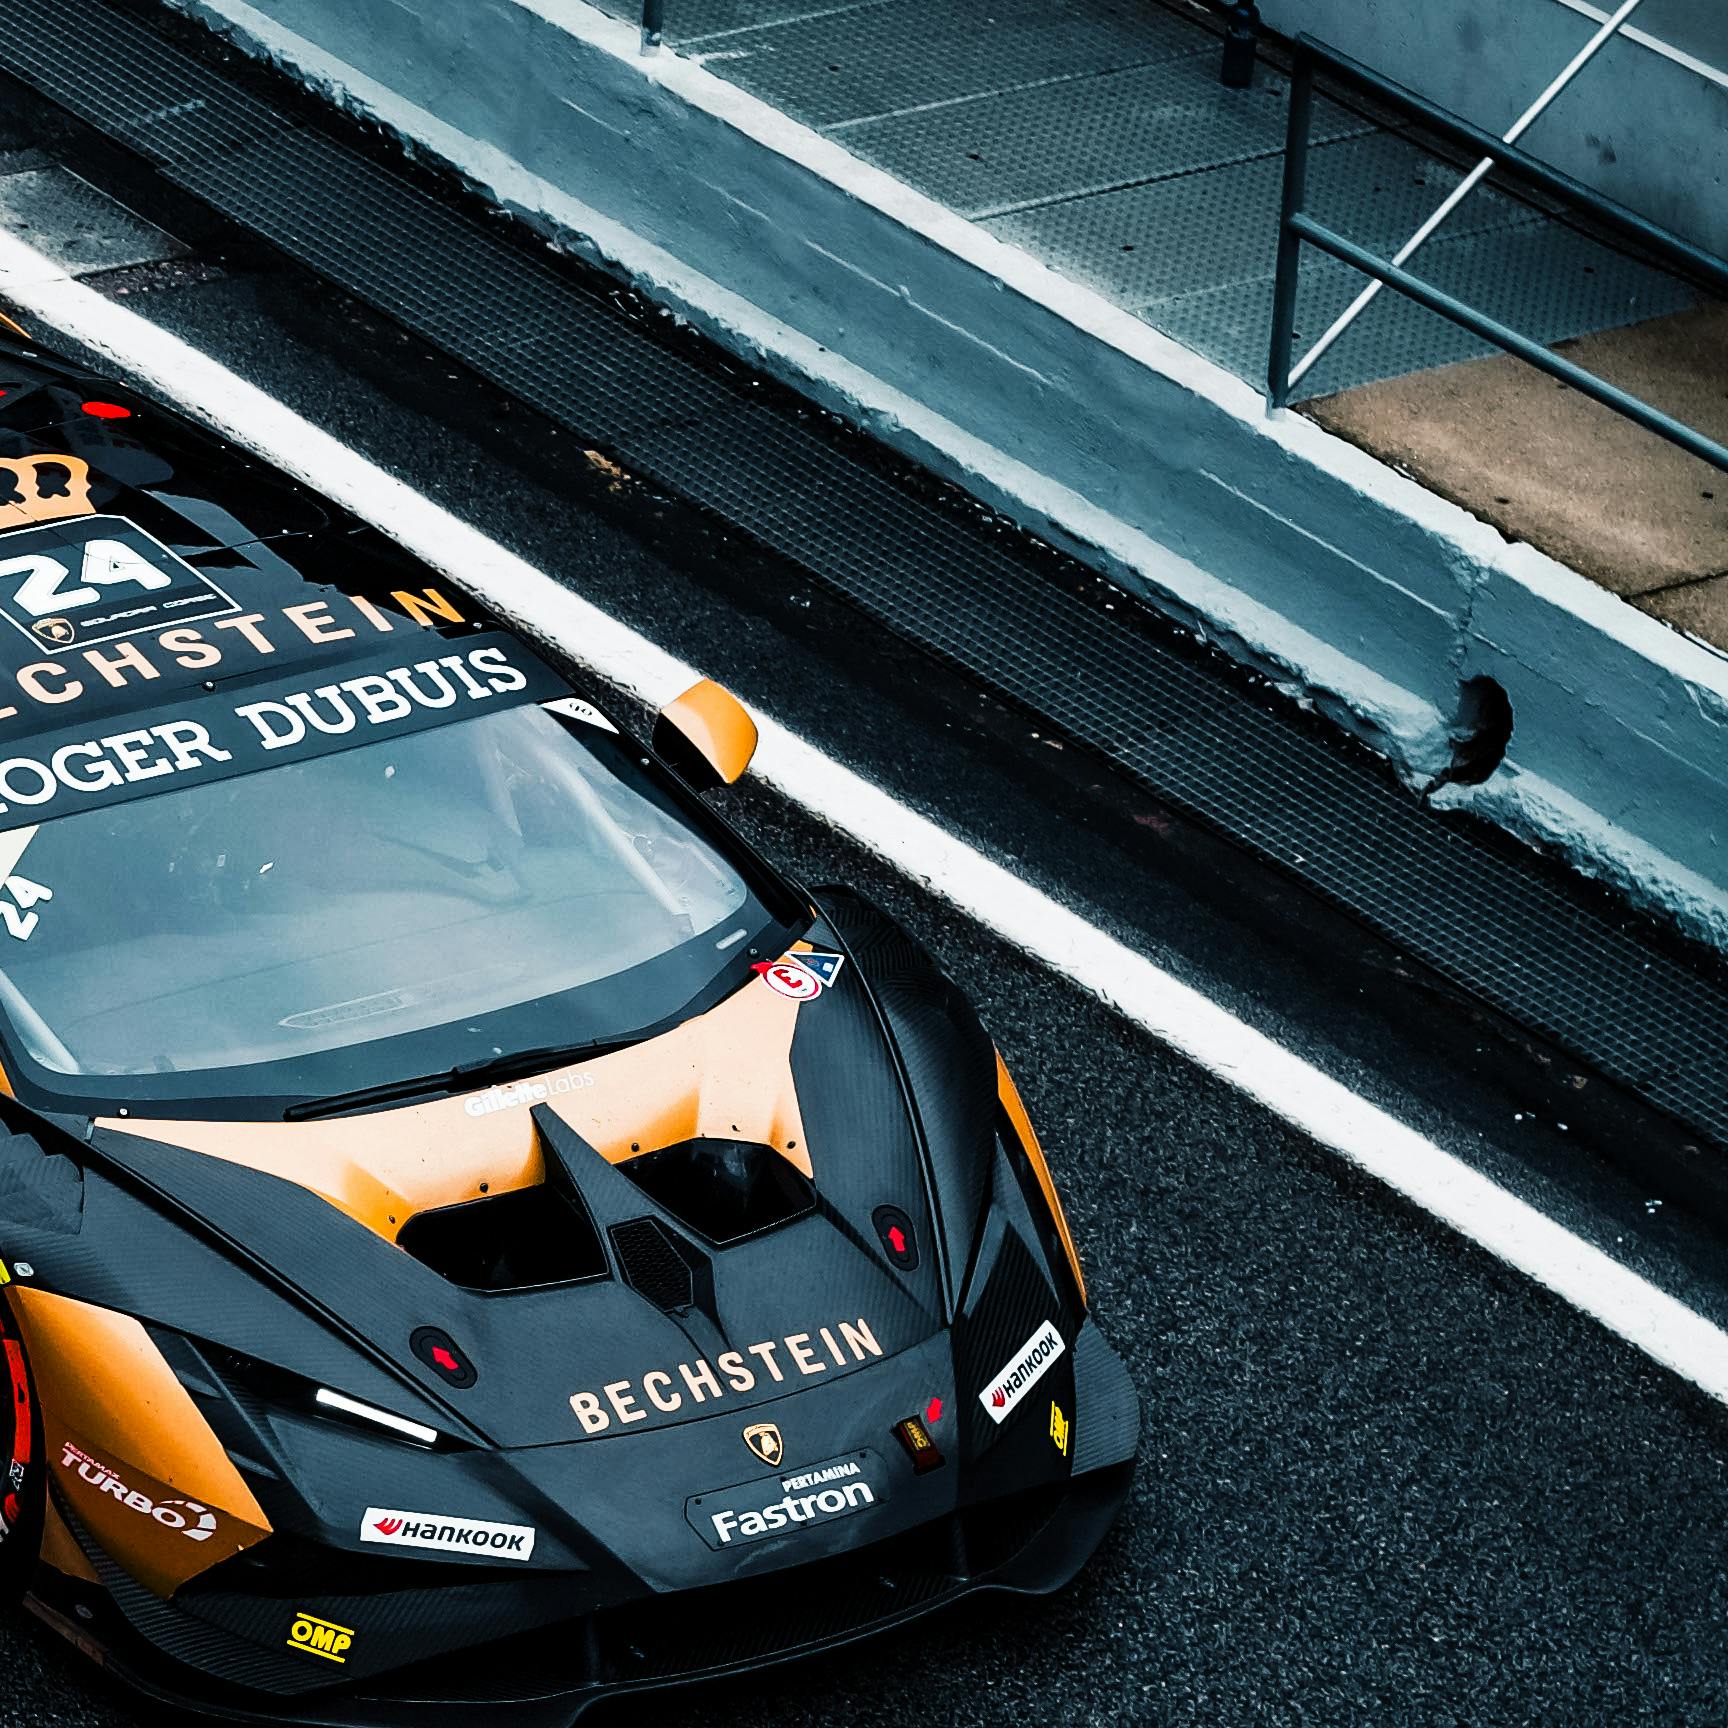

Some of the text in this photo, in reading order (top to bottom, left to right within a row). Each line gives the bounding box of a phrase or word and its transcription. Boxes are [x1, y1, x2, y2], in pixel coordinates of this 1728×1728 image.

[234, 647, 528, 751] DUBUIS
[569, 1317, 885, 1434] BECHSTEIN
[60, 1447, 186, 1529] TURBO
[63, 1441, 121, 1480] PERTAMAX
[781, 1461, 862, 1493] PERTAMINA
[711, 1480, 874, 1543] Fastron
[291, 1619, 352, 1655] OMP
